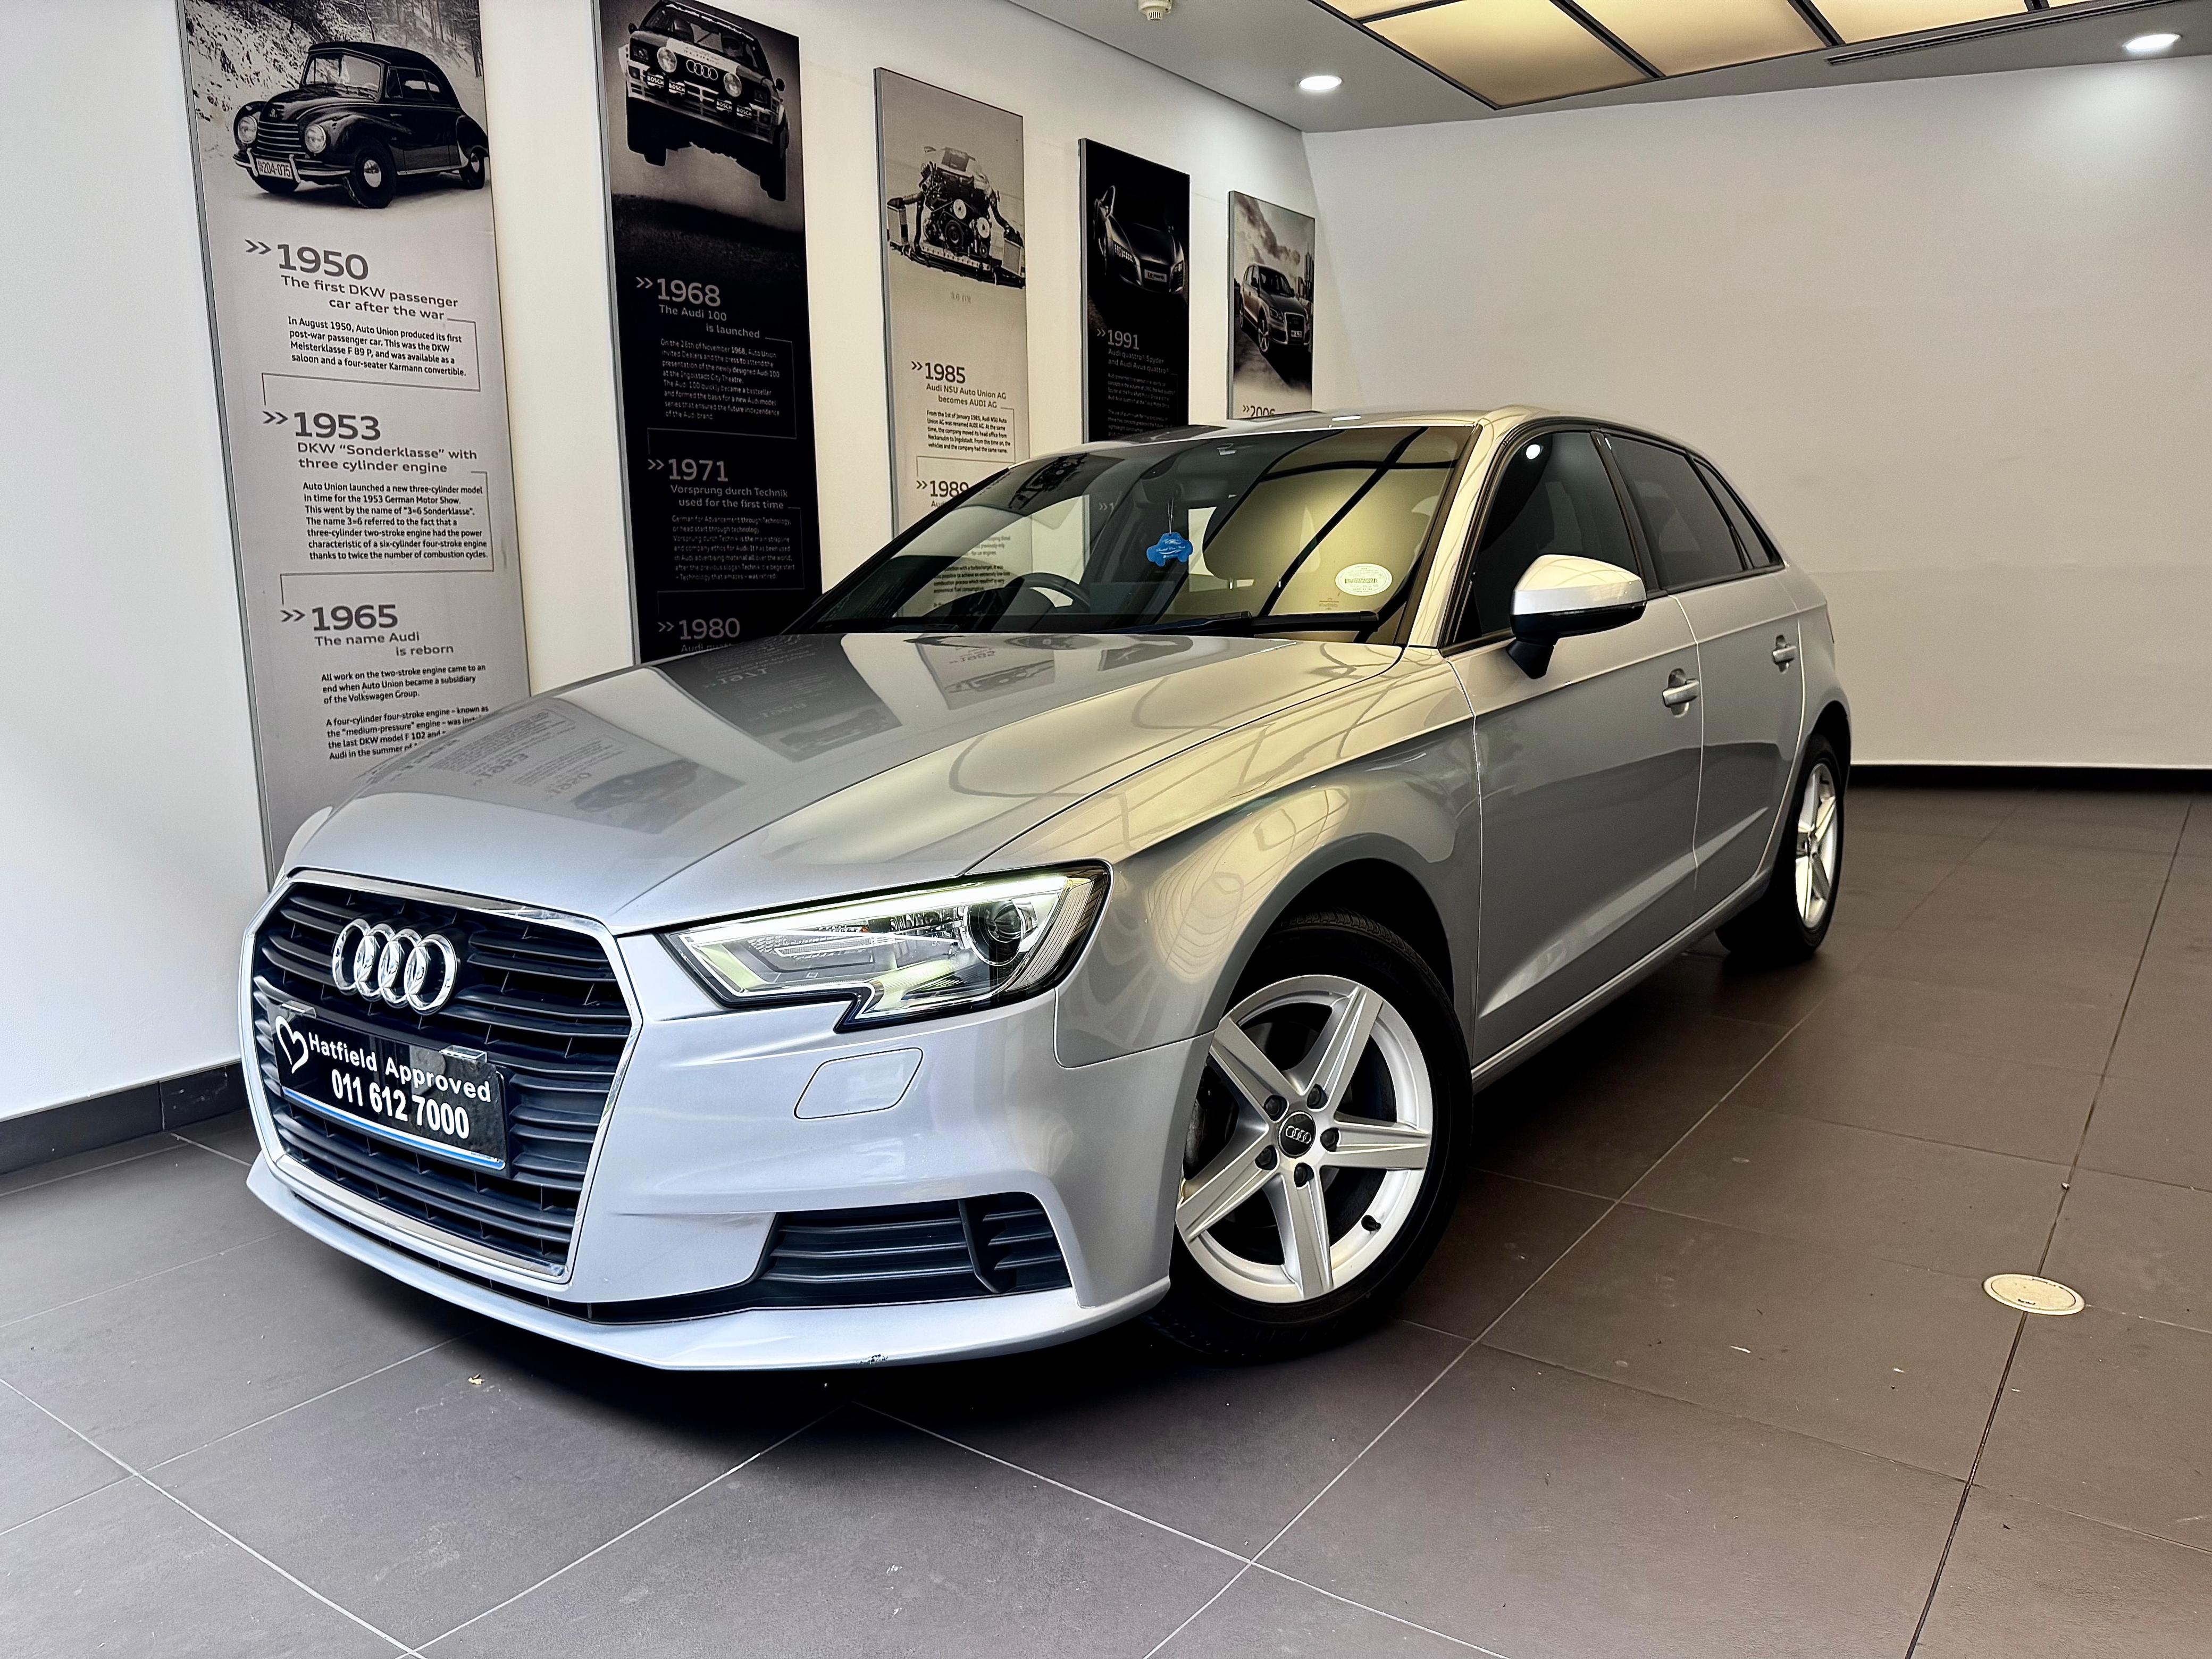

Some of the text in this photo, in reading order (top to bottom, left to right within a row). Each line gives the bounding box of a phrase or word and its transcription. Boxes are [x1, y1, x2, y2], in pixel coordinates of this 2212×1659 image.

[647, 76, 664, 86] BOSCH
[669, 82, 685, 93] BOSCH
[716, 100, 732, 110] BOSCH
[736, 107, 752, 116] BOSCH
[278, 244, 368, 279] 1950
[281, 274, 457, 307] The first DKW passenger
[658, 279, 720, 306] 1968
[329, 299, 444, 320] car after the war
[659, 304, 726, 321] The Audi 100
[288, 316, 297, 325] In
[299, 317, 328, 329] August
[330, 321, 354, 332] 1950,
[376, 326, 398, 336] Union
[400, 330, 434, 340] produced
[436, 332, 445, 341] its
[447, 333, 462, 342] first
[706, 323, 759, 338] is launched
[289, 330, 325, 340] post-war
[328, 334, 367, 346] passenger
[384, 338, 400, 348] This
[417, 342, 430, 351] the
[431, 343, 449, 352] DKW
[1108, 330, 1139, 349] 1991
[290, 341, 345, 354] Meisterklasse
[354, 347, 364, 356] 89
[366, 348, 373, 358] P,
[407, 354, 439, 363] available
[291, 354, 319, 363] saloon
[321, 356, 336, 365] and
[344, 357, 387, 369] four-seater
[389, 362, 422, 372] Karmann
[424, 367, 466, 376] convertible.
[925, 363, 966, 383] 1985
[926, 383, 942, 391] Audi
[943, 385, 958, 393] NSU
[977, 389, 995, 398] Union
[938, 395, 967, 405] becomes
[969, 398, 986, 407] AUDI
[295, 412, 380, 440] 1953
[298, 442, 334, 453] DKW
[448, 449, 476, 459] with
[298, 458, 447, 474] three cylinder engine
[669, 459, 727, 481] 1971
[324, 482, 347, 491] Union
[409, 485, 458, 495] three-cylinder
[671, 484, 787, 497] Vorsprung durch Technik
[705, 498, 719, 506] for
[722, 499, 738, 507] the
[741, 499, 760, 508] first
[313, 604, 397, 631] 1965
[680, 618, 740, 639] 1980
[314, 631, 419, 646] The name Audi
[396, 646, 453, 656] is reborn
[381, 668, 420, 677] two-stroke
[422, 667, 446, 676] engine
[323, 695, 332, 704] of
[334, 694, 347, 703] the
[348, 692, 393, 701] Volkswagen
[308, 1032, 492, 1103] Hatfield Approved
[331, 1069, 470, 1139] 011 612 7000
